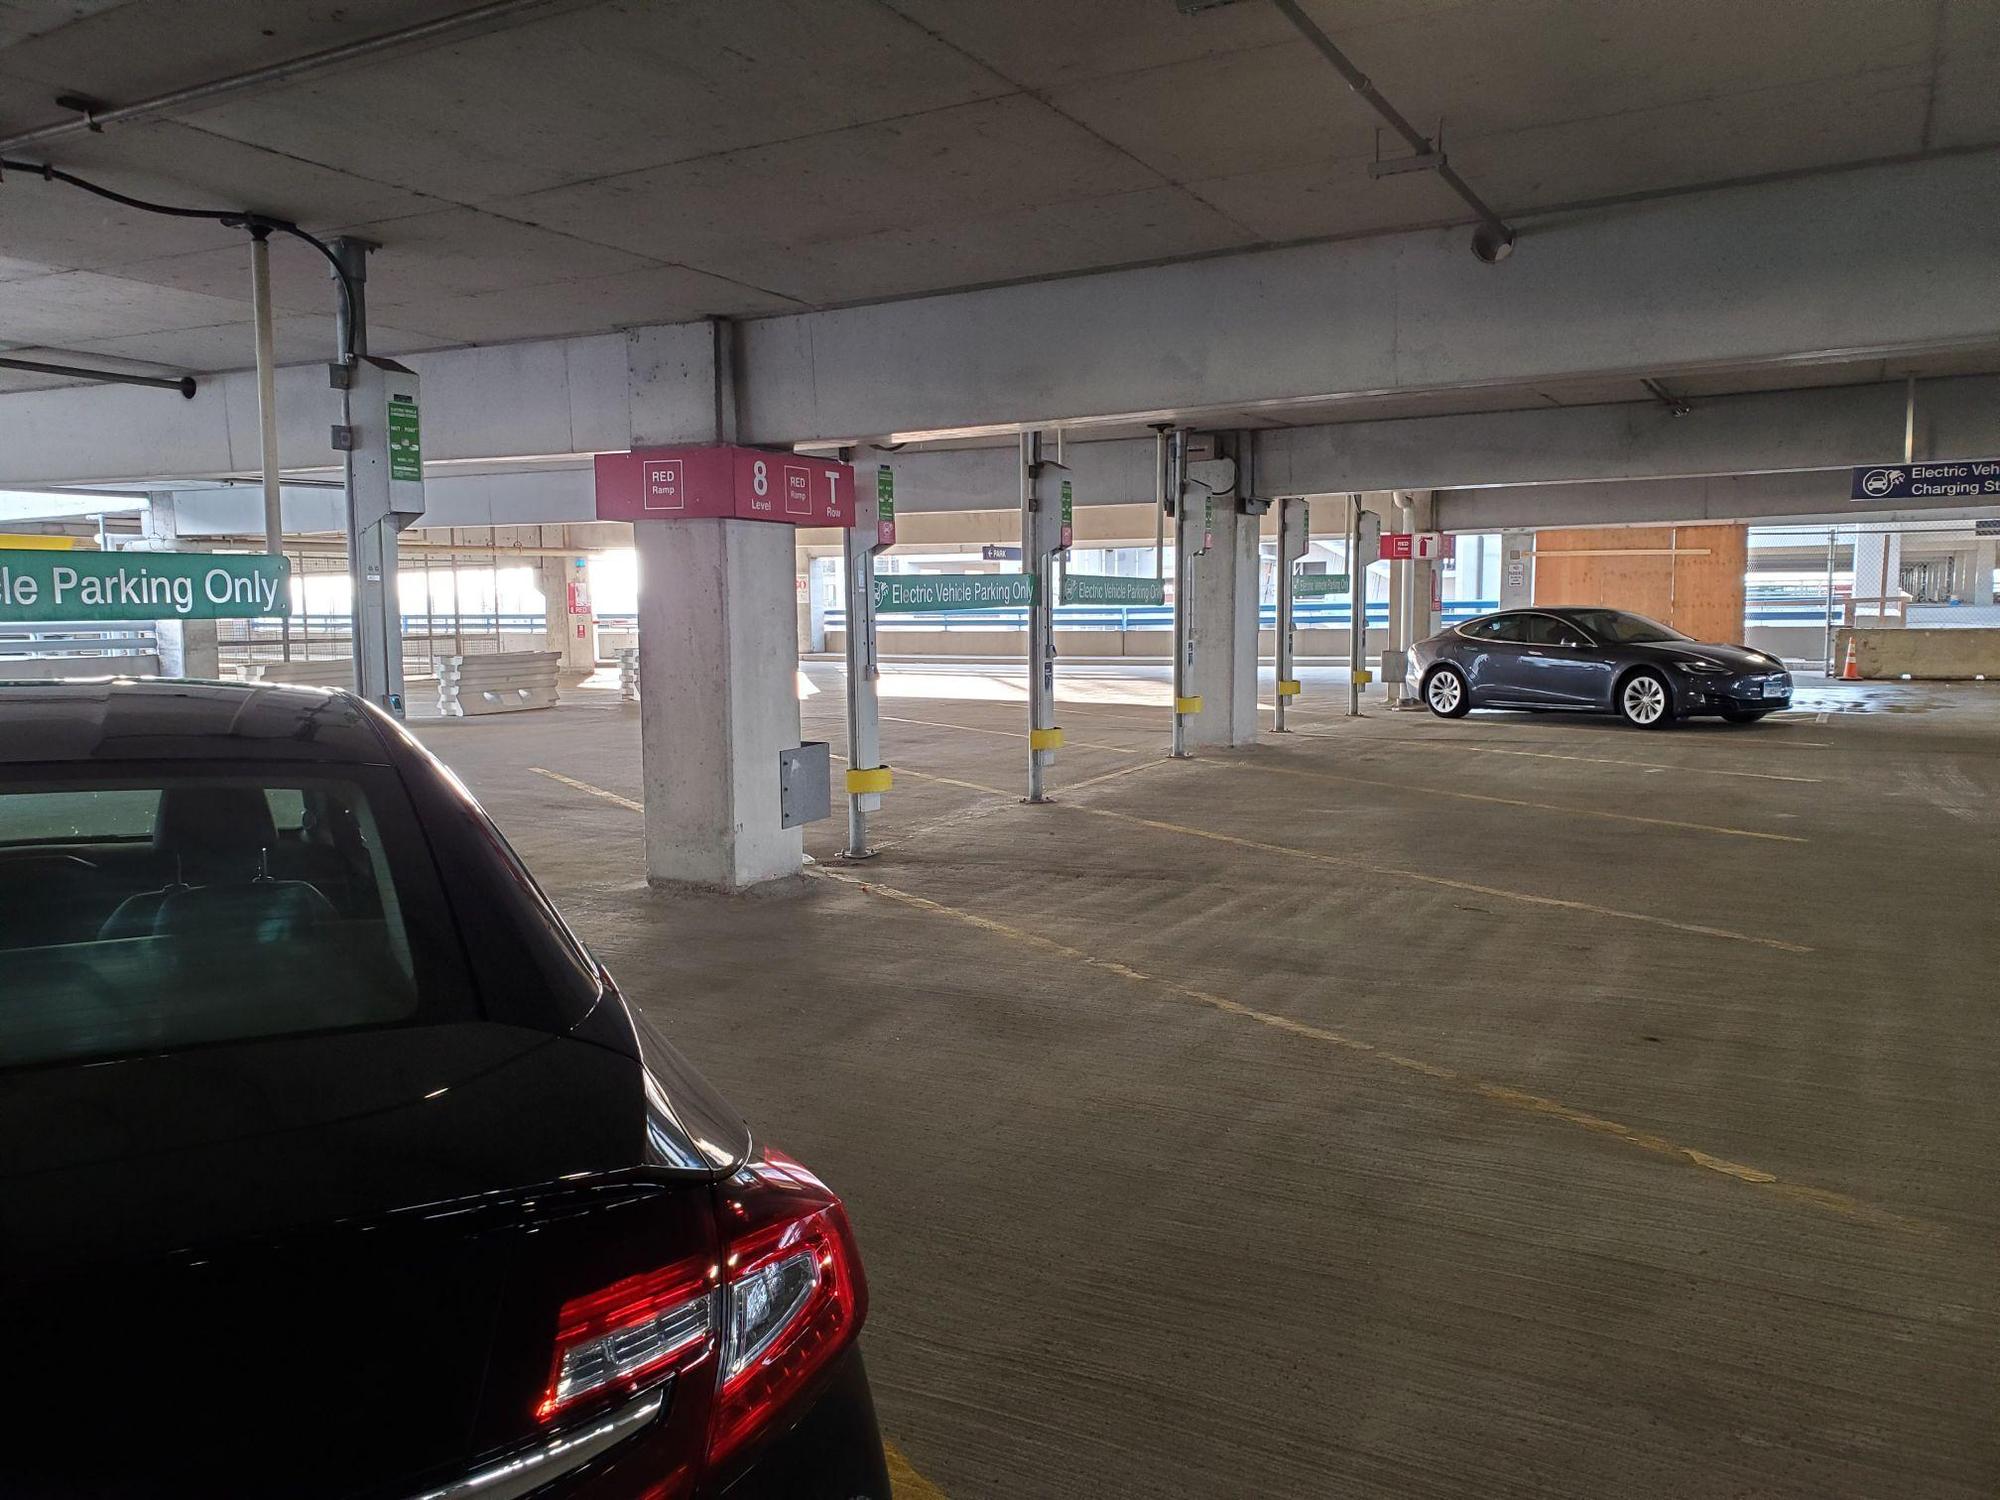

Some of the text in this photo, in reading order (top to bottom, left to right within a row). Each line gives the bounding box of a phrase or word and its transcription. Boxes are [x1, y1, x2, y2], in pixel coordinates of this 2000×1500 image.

[652, 471, 674, 482] RED
[1912, 464, 2000, 479] Electric Veh
[754, 461, 767, 496] 8
[790, 476, 805, 488] RED
[652, 486, 675, 495] Ramp
[825, 471, 840, 504] T
[1912, 483, 1979, 495] Charging
[791, 490, 806, 501] Ramp
[752, 499, 771, 511] Level
[827, 507, 841, 517] Row
[0, 566, 278, 613] le Parking Only
[892, 581, 1034, 604] Electric Vehicle Parking Only
[1079, 582, 1103, 599] Electric
[1104, 583, 1126, 599] Vehicle
[1127, 584, 1149, 602] Parking
